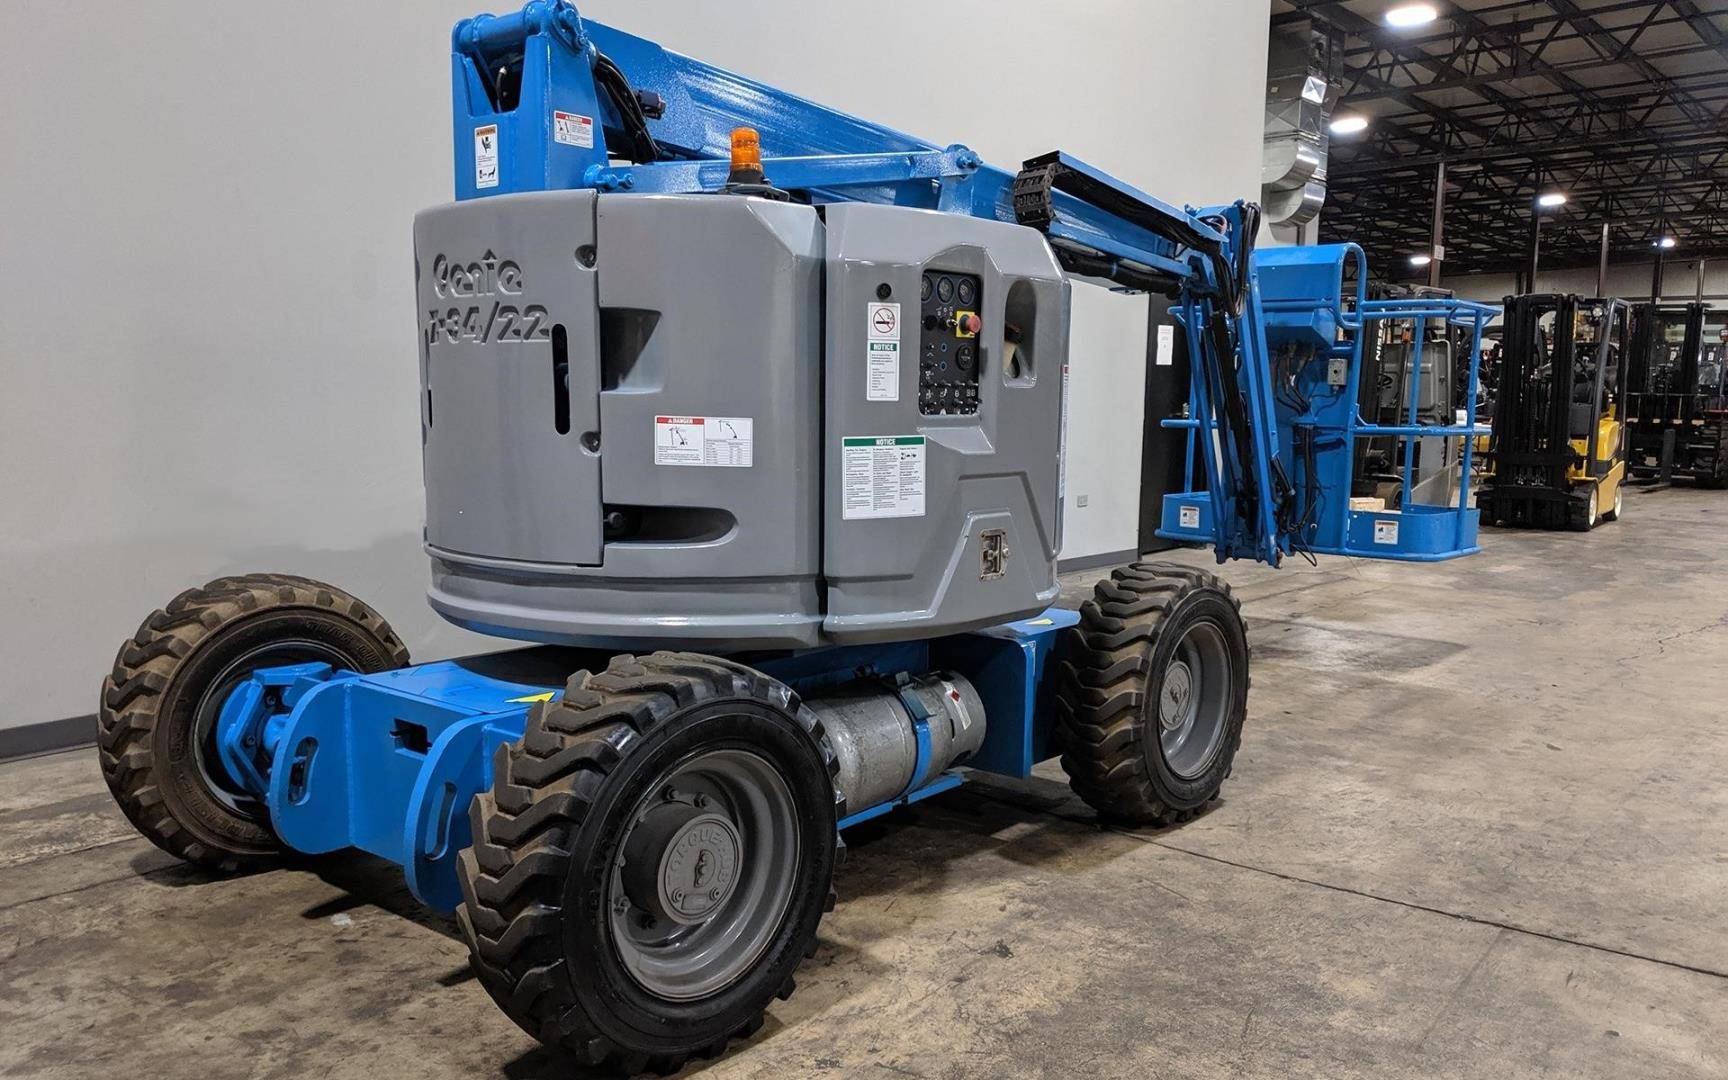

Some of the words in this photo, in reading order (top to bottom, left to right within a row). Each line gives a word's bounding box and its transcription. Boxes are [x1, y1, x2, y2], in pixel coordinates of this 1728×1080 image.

[433, 249, 522, 299] Genie
[873, 343, 894, 351] NOTICE
[875, 438, 896, 446] NOTICE
